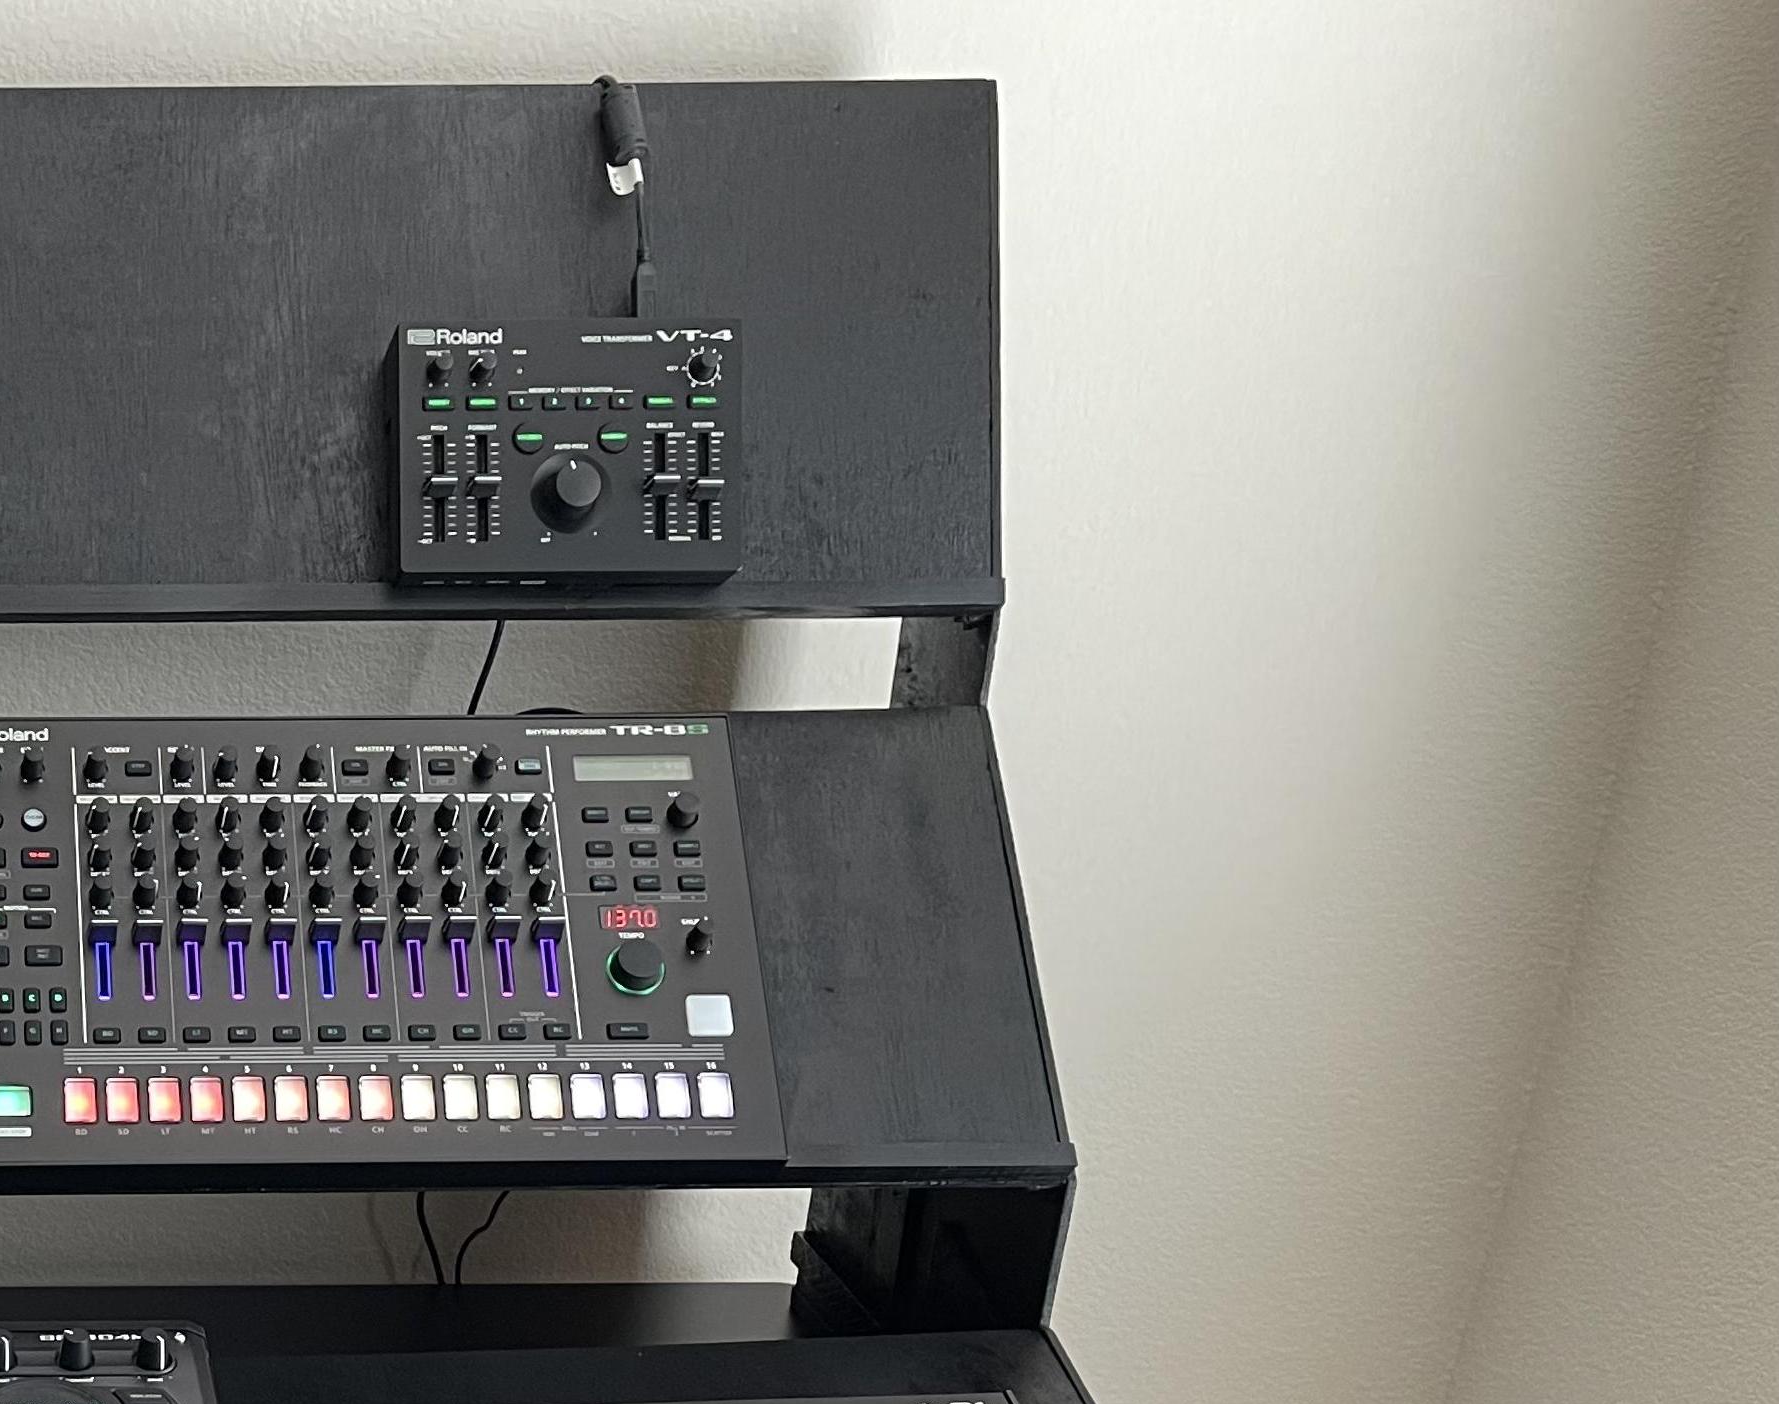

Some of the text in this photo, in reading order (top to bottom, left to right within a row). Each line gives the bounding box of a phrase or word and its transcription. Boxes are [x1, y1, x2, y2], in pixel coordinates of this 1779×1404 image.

[436, 328, 503, 345] Roland
[656, 329, 733, 342] VT-4
[610, 724, 709, 735] TR-8S
[77, 1066, 82, 1074] 1
[118, 1066, 124, 1074] 2
[160, 1066, 166, 1074] 3
[286, 1064, 292, 1072] 6
[329, 1064, 334, 1072] 7
[370, 1064, 376, 1072] 8
[413, 1064, 419, 1072] 9
[453, 1064, 463, 1072] 10
[537, 1063, 548, 1071] 12
[622, 1062, 633, 1070] 14
[664, 1062, 675, 1070] 15
[706, 1062, 716, 1070] 16
[75, 1128, 88, 1136] BD
[118, 1128, 130, 1136] SD
[288, 1126, 299, 1134] RS
[371, 1126, 384, 1134] CH
[500, 1125, 512, 1133] RC
